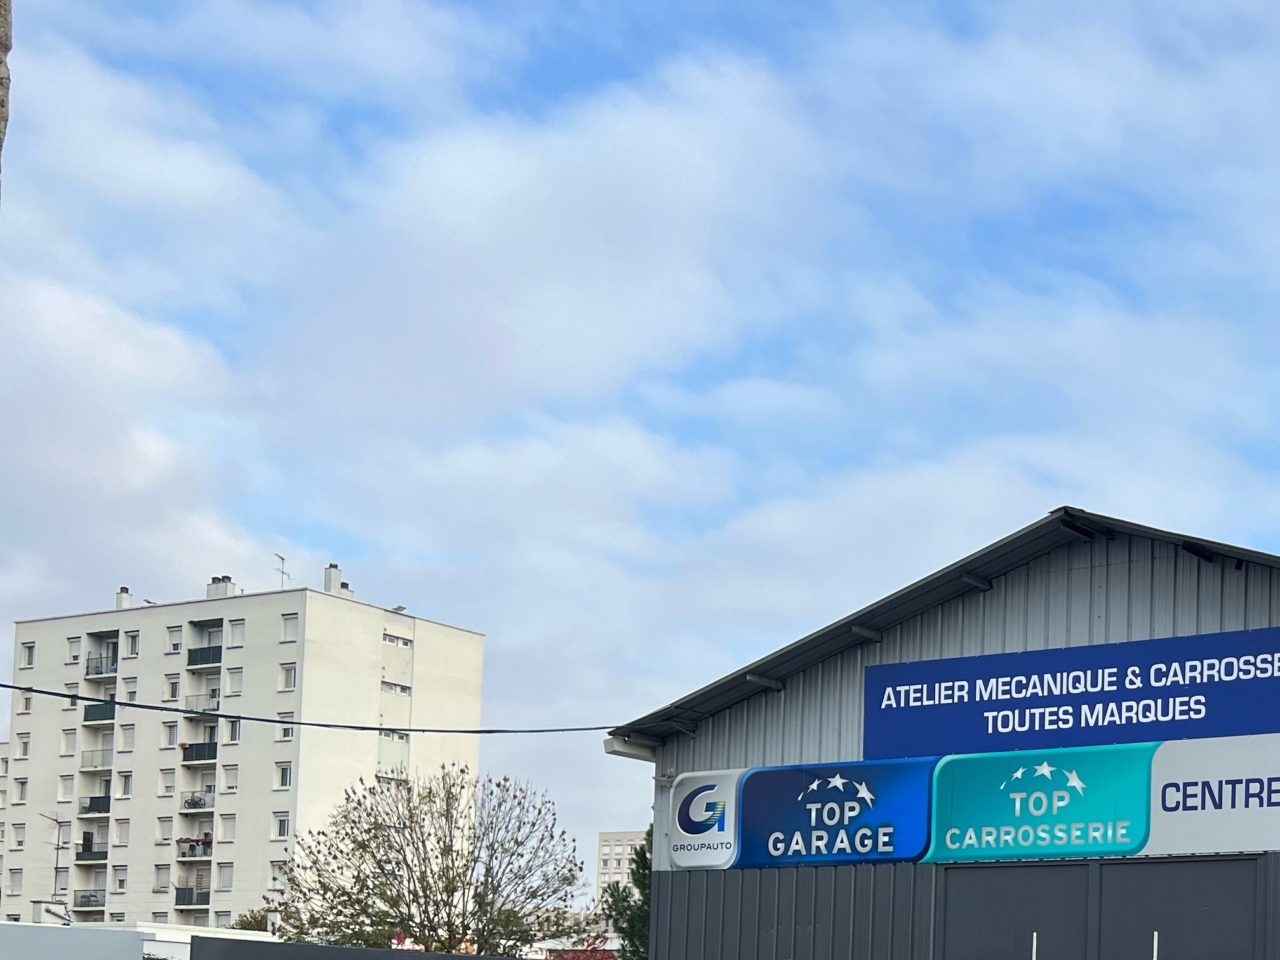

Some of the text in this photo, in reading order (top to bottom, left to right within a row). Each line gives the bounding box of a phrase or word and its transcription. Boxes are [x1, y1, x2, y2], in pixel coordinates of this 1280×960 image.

[880, 680, 968, 709] ATELIER
[976, 667, 1117, 700] MECANIQUE
[1125, 666, 1142, 688] &
[984, 696, 1205, 734] TOUTES MARQUES
[806, 801, 860, 826] TOP
[1010, 790, 1070, 817] TOP
[672, 841, 732, 852] GROUPAUTO
[768, 827, 894, 856] GARAGE
[945, 820, 1132, 849] CARROSSERIE
